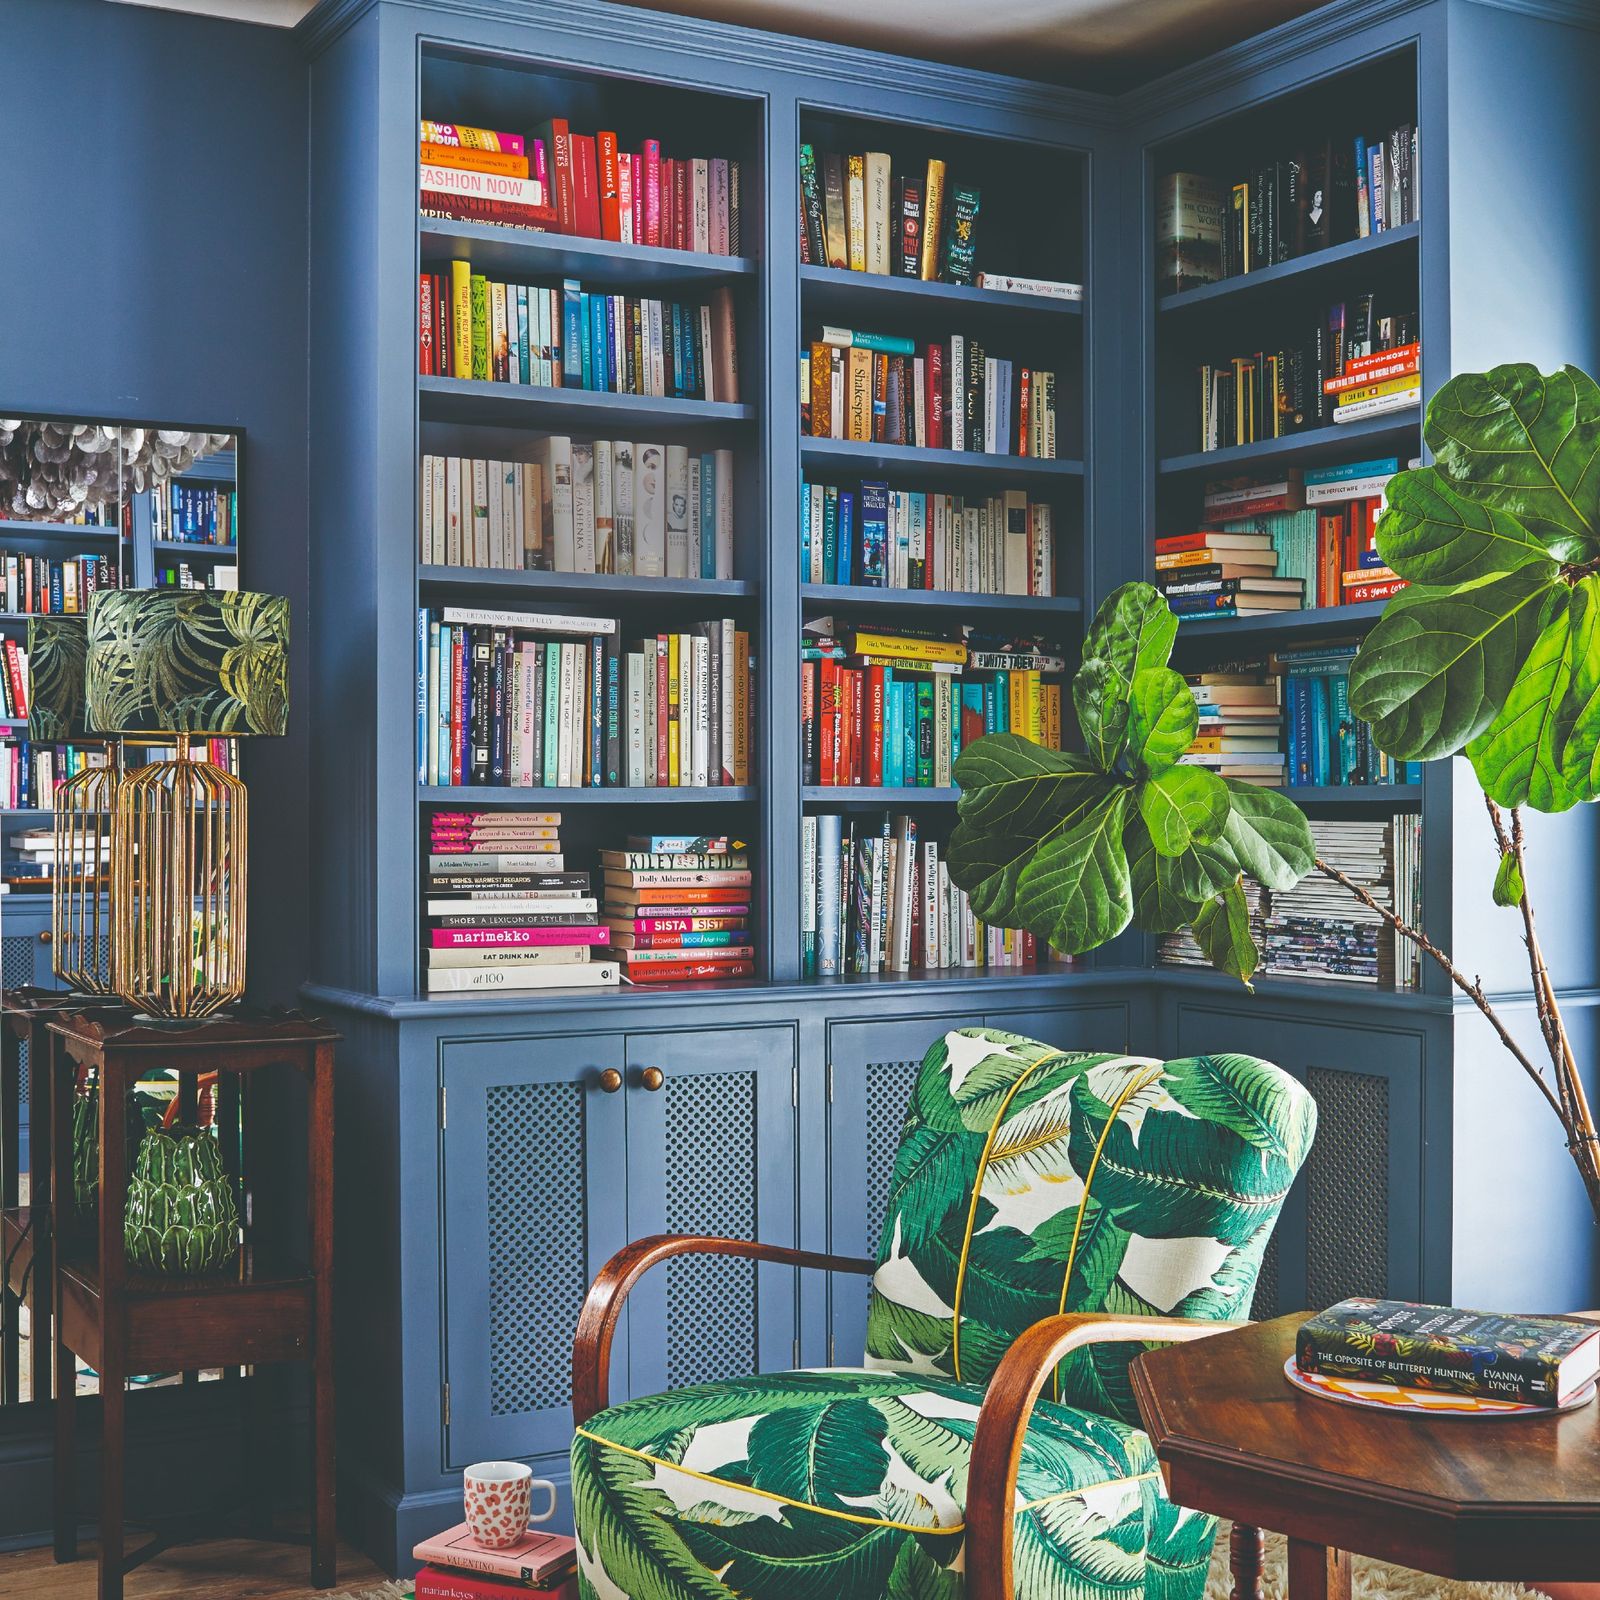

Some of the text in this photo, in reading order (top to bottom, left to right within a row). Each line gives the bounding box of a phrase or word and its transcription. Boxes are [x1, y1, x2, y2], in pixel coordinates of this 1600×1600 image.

[429, 124, 453, 137] TWO
[430, 137, 456, 150] FOUR
[555, 135, 565, 167] OATES
[604, 137, 614, 189] TOM HANKS
[491, 178, 524, 197] NOW
[926, 185, 937, 250] HILARY MANTEL
[421, 284, 432, 329] POWER
[463, 335, 471, 366] WEATHER
[570, 332, 578, 365] SHREVE
[970, 341, 979, 385] PULLMAN
[852, 368, 866, 440] Shakespeare
[955, 345, 963, 449] SILENCE GIRLS BARKER
[1020, 387, 1029, 409] SHE'S
[1046, 382, 1057, 412] EMPIRE
[705, 464, 713, 517] GREAT AT WORK
[1326, 487, 1346, 495] PERFECT
[692, 502, 700, 537] SOMEWHERE
[803, 487, 811, 540] WODEHOUSE
[826, 506, 834, 558] LET YOU GO
[913, 517, 922, 546] SLAP
[1354, 587, 1388, 599] it's your
[902, 644, 920, 652] Other
[512, 660, 521, 682] Design
[711, 653, 719, 672] Ellen
[983, 653, 1035, 671] WHITE TIGER
[608, 656, 617, 710] ABIGAIL AHERN
[711, 673, 719, 714] DeGeneres
[461, 666, 469, 750] Making Living Lovely
[512, 688, 520, 712] healthy
[523, 665, 533, 735] resourceful living
[737, 696, 744, 706] TO
[821, 681, 833, 718] RIVAL
[874, 684, 882, 722] NORTON
[833, 713, 842, 764] Paulo Coelho
[477, 815, 539, 824] Leopard Neutral
[475, 830, 501, 838] Leopard
[477, 843, 538, 852] Leopard Neutral
[629, 853, 734, 870] KILEY REID
[474, 876, 503, 884] WARMEST
[503, 876, 532, 884] REGARDS
[639, 874, 692, 884] Dolly Alderton
[816, 854, 826, 916] FLOWERS
[880, 823, 891, 943] DICTIONARY GARDEN PLANTS
[927, 864, 936, 886] WORLD
[476, 892, 498, 900] TALK
[524, 891, 539, 899] TED
[912, 865, 920, 917] WODEHOUSE
[952, 890, 960, 915] Design
[873, 879, 881, 932] WILD HOME
[449, 917, 476, 925] SHOES
[489, 916, 525, 924] LEXICON
[540, 915, 563, 923] STYLE
[654, 920, 688, 931] SISTA
[941, 912, 949, 947] Asymmetry
[452, 930, 530, 944] marimekko
[653, 936, 701, 944] COMFORT BOOK
[498, 952, 522, 960] DRINK
[472, 972, 504, 985] at 100
[1316, 1351, 1476, 1382] THE OPPOSITE OF BUTTERFLY HUNTING
[1483, 1369, 1525, 1384] EVANNA
[1487, 1380, 1520, 1393] LYNCH
[446, 1555, 495, 1573] VALENTINO
[421, 1586, 451, 1598] marian
[451, 1588, 474, 1600] keyes
